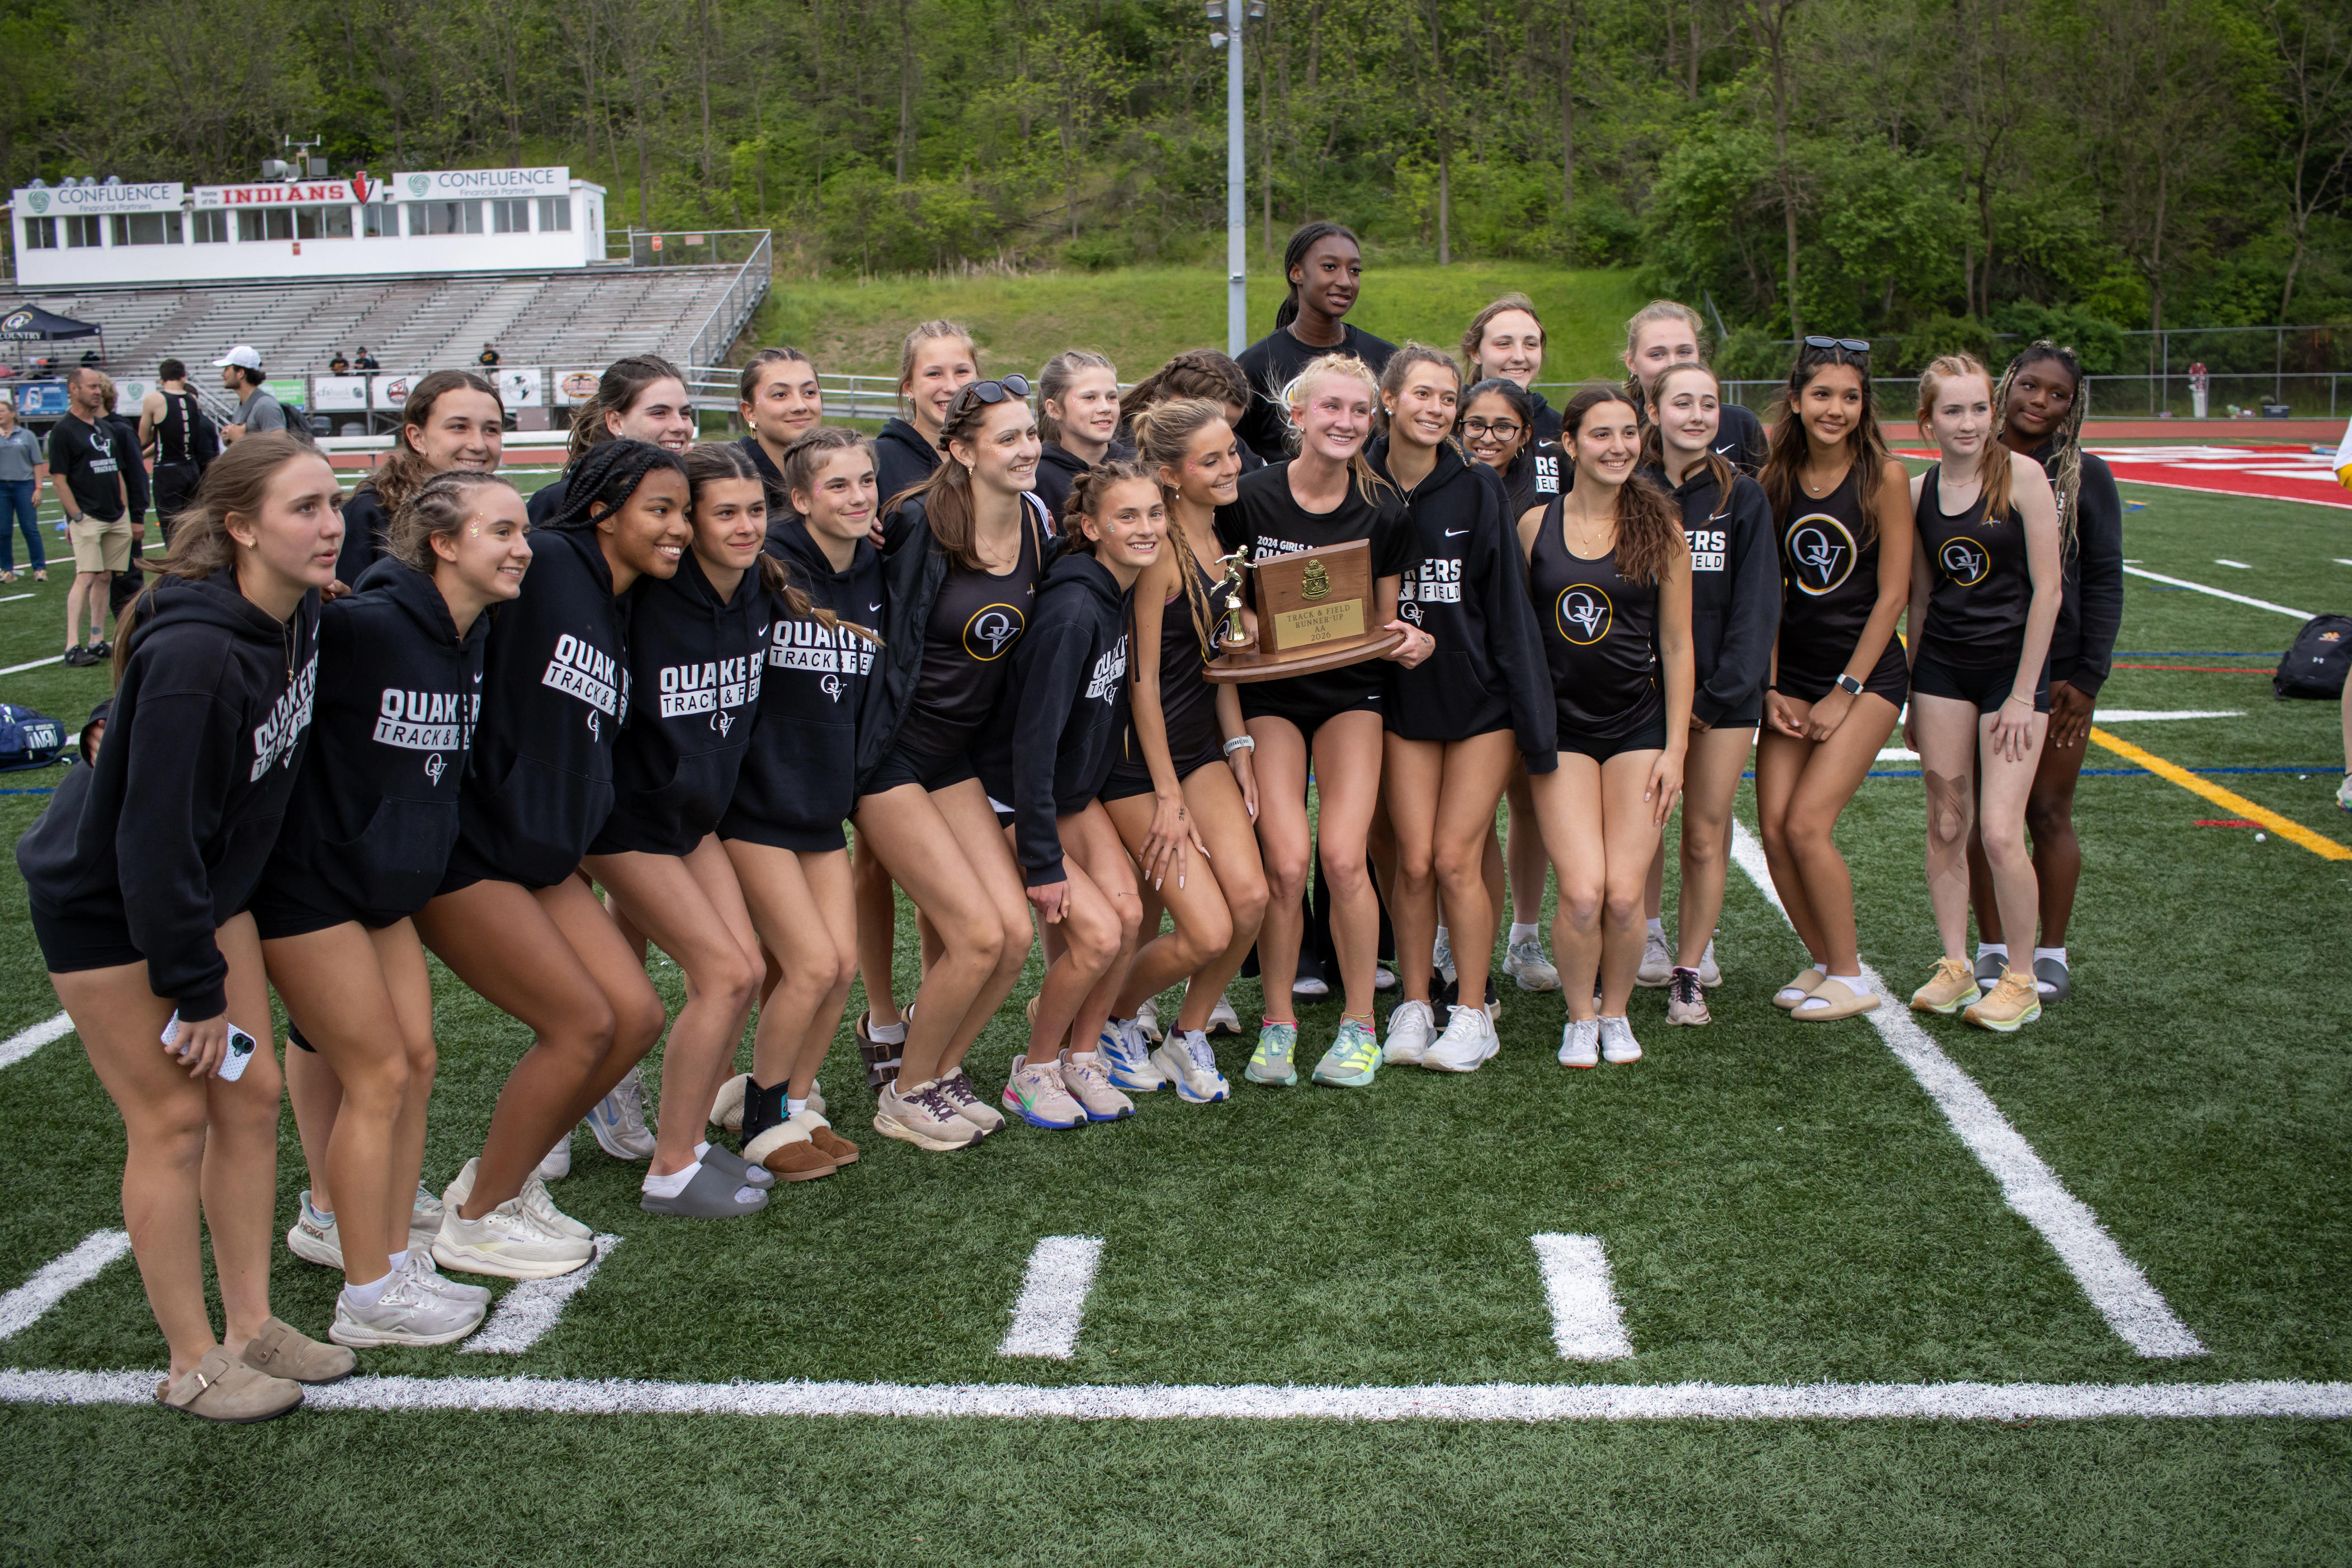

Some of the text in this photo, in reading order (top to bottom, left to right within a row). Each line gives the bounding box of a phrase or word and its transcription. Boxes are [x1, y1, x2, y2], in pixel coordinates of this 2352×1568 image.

[438, 169, 555, 187] CONFLUENCE
[58, 185, 171, 204] CONFLUENCE
[223, 185, 344, 204] INDIANS
[501, 187, 535, 195] Partners
[79, 204, 116, 212] Financial
[1534, 456, 1558, 475] RS
[1257, 536, 1278, 549] 2024
[1279, 541, 1305, 552] GIRLS
[1684, 531, 1726, 551] ERS
[1792, 528, 1846, 584] QV
[1944, 545, 1983, 580] QV
[1424, 585, 1460, 599] FIELD
[1287, 611, 1314, 622] TRACK
[1326, 604, 1350, 615] FIELD
[1295, 613, 1343, 628] RUNNER-UP
[1401, 602, 1425, 627] QV
[1562, 592, 1607, 638] QV
[975, 612, 1020, 654] QV
[1311, 632, 1331, 641] 2026
[773, 650, 832, 668] TRACK
[550, 665, 609, 706] TRACK &
[820, 674, 847, 703] QV
[663, 692, 717, 712] TRACK
[724, 689, 733, 704] &
[381, 722, 442, 746] TRACK
[443, 729, 451, 745] &
[425, 753, 447, 786] QV
[300, 1220, 324, 1241] HOKA
